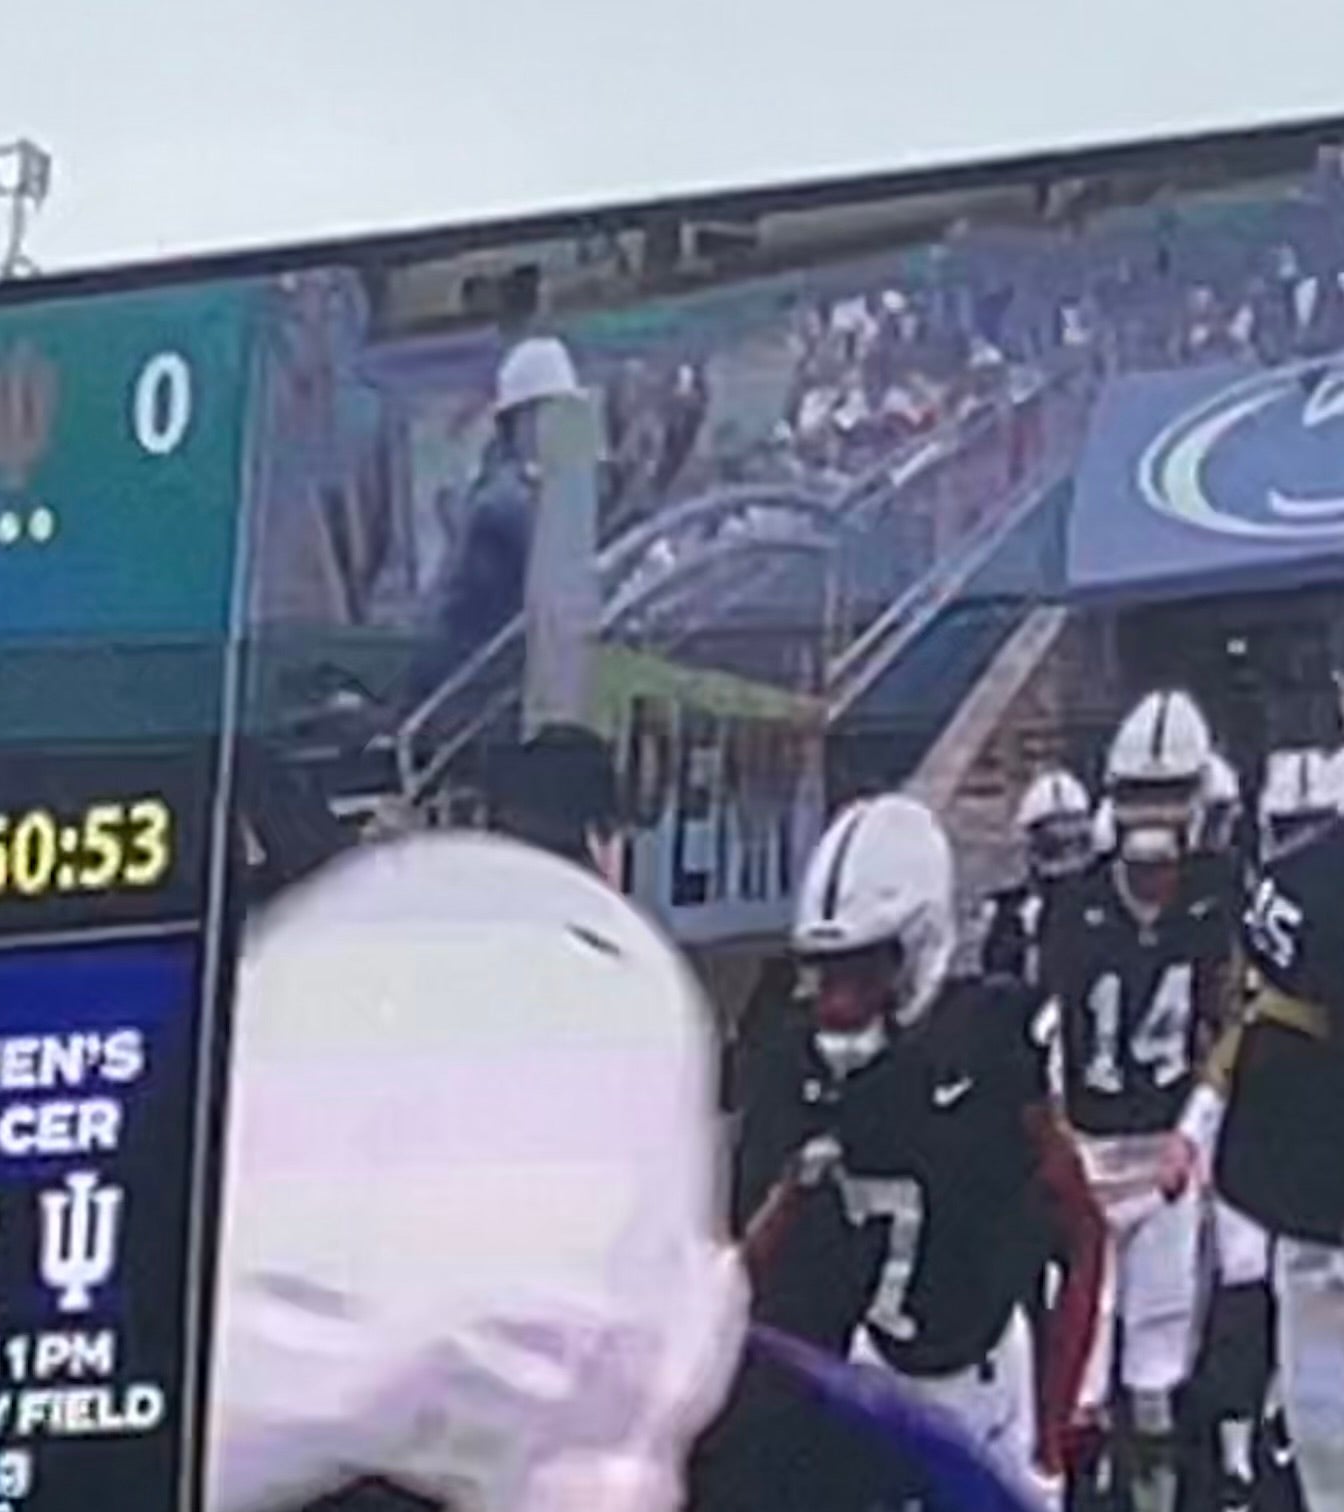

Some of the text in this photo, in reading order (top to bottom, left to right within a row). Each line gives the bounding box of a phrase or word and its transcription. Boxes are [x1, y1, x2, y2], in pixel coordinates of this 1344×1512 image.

[134, 351, 192, 455] 0
[1086, 963, 1193, 1094] 14
[839, 1173, 923, 1341] 7
[15, 1382, 167, 1435] FIELD
